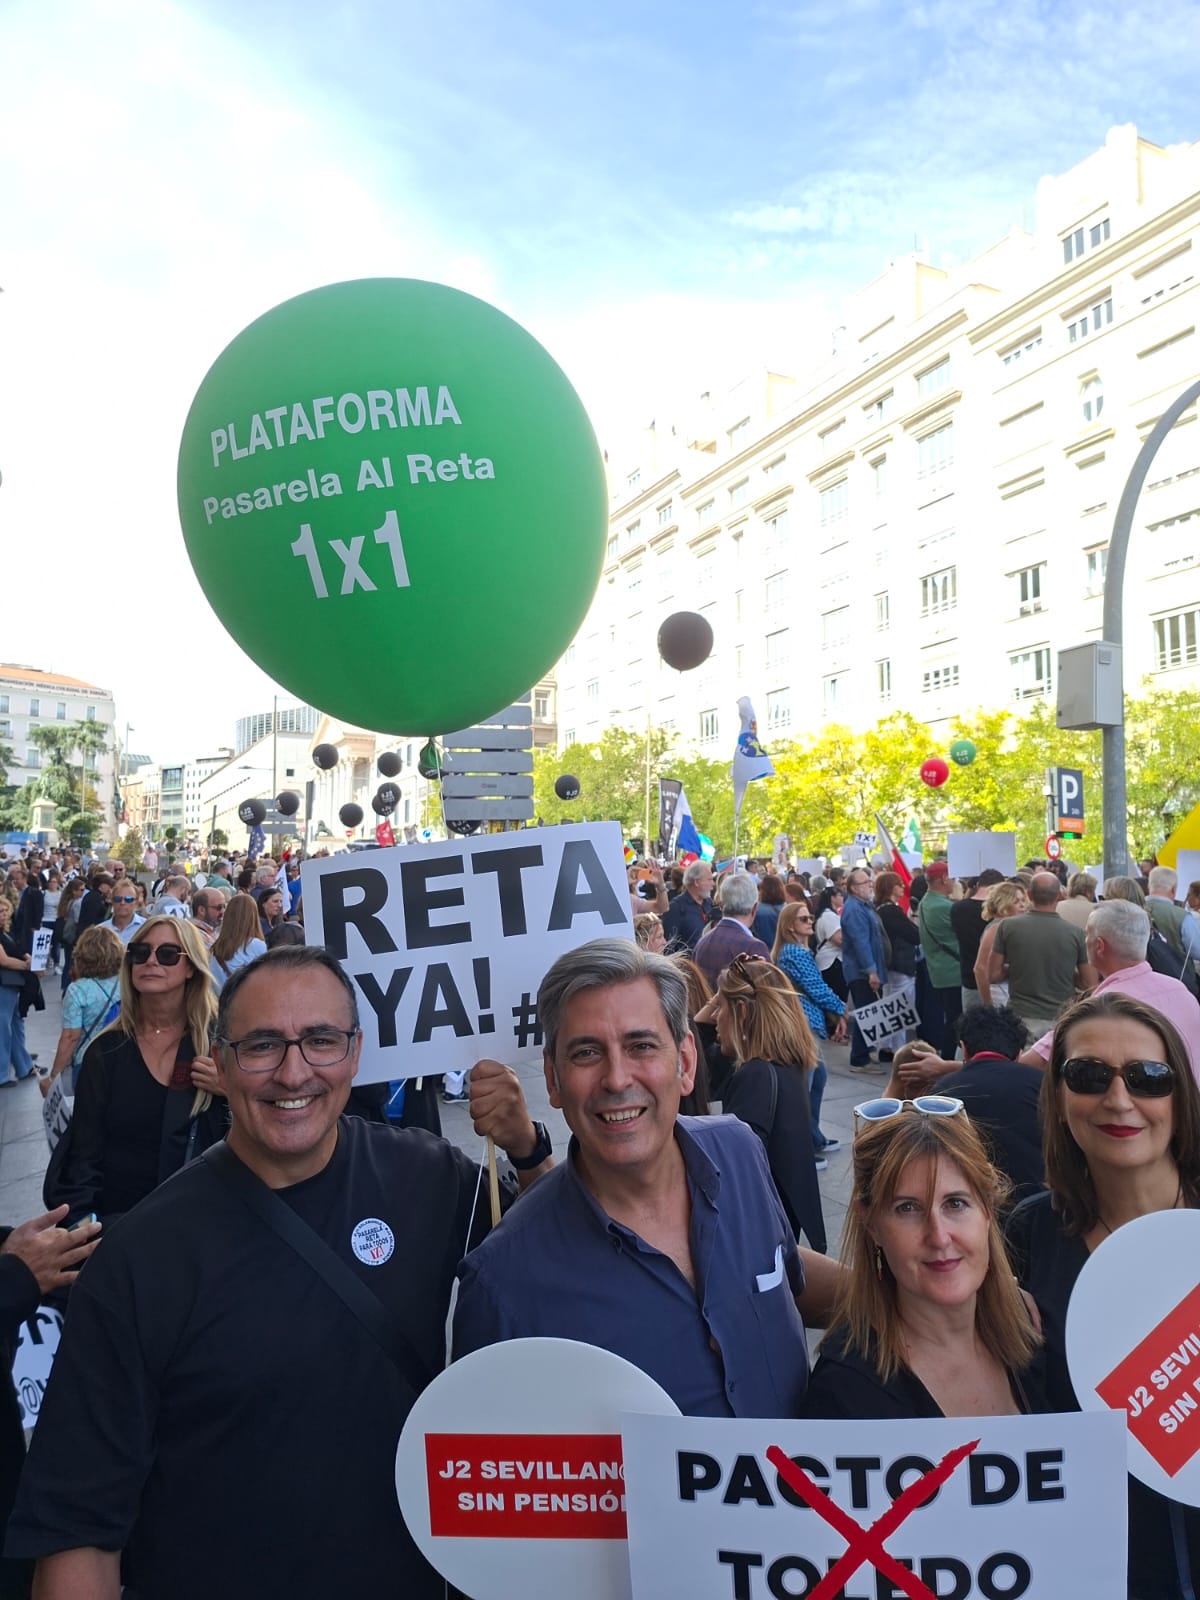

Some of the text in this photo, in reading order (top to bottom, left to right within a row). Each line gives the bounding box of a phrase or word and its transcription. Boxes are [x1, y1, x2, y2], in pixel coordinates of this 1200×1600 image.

[210, 385, 462, 467] PLATAFORMA
[203, 452, 496, 524] Pasarela Al Reta
[290, 510, 411, 599] 1x1
[1061, 774, 1079, 815] P
[320, 839, 628, 960] RETA
[354, 956, 496, 1049] YA!
[856, 1005, 878, 1021] #J2
[863, 1009, 917, 1042] RETA
[1128, 1386, 1154, 1417] J2
[1158, 1392, 1198, 1433] SIN
[439, 1460, 472, 1479] J2
[677, 1449, 1066, 1509] PACTO DE
[458, 1492, 504, 1511] SIN
